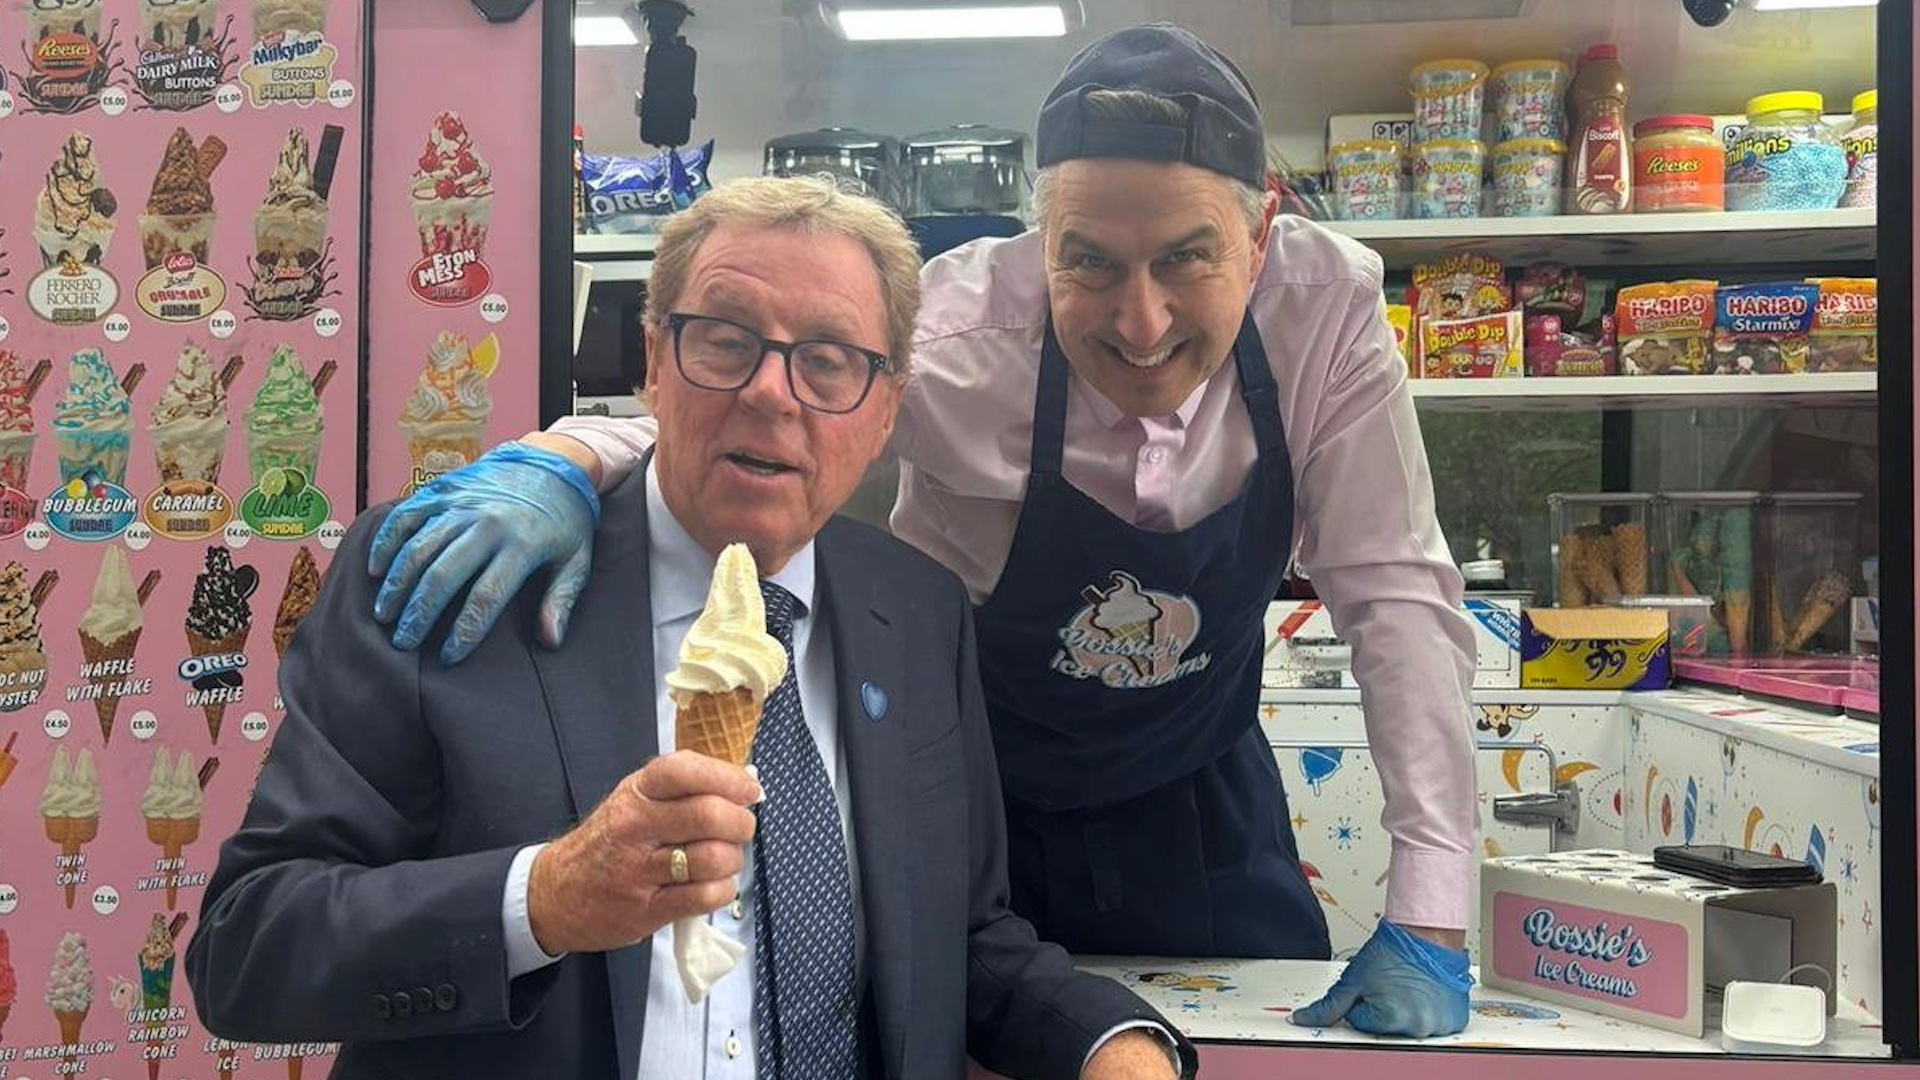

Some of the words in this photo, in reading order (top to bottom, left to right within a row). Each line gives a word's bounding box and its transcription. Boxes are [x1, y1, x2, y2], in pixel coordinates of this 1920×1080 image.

[253, 38, 322, 64] Milkybar
[137, 62, 180, 80] DAIRY
[180, 54, 218, 71] MILK
[273, 68, 326, 81] BUTTONS
[164, 76, 217, 90] BUTTONS
[590, 187, 674, 216] OREO
[432, 248, 477, 270] ETON
[1415, 254, 1467, 282] Double
[1471, 256, 1501, 277] Dip
[46, 278, 102, 291] FERRERO
[418, 265, 465, 288] MESS
[46, 291, 102, 305] ROCHER
[1631, 292, 1706, 317] HARIBO
[1727, 295, 1807, 316] HARIBO
[1815, 292, 1877, 313] HARIB
[1429, 323, 1477, 353] Double
[1478, 322, 1506, 342] Dip
[42, 497, 138, 514] BUBBLEGUM
[152, 493, 225, 513] CARAMEL
[253, 492, 314, 519] LIME
[261, 521, 305, 536] SUNDAE
[79, 657, 136, 679] WAFFLE
[180, 654, 248, 678] OREO
[1585, 647, 1627, 682] 99
[19, 668, 46, 684] NUT
[66, 681, 103, 702] WITH
[107, 677, 152, 698] FLAKE
[186, 686, 244, 706] WAFFLE
[55, 854, 87, 868] TWIN
[155, 857, 186, 871] TWIN
[56, 870, 88, 885] CONE
[138, 876, 169, 892] WITH
[171, 871, 207, 888] FLAKE
[1523, 907, 1653, 967] Bossie's
[1535, 953, 1564, 982] Ice
[1563, 959, 1638, 998] Creams
[127, 1005, 186, 1024] UNICORN
[127, 1024, 189, 1042] RAINBOW
[24, 1038, 117, 1061] MARSHMALLOW
[143, 1045, 177, 1061] CONE
[54, 1061, 87, 1075] CONE
[216, 1057, 240, 1071] ICE
